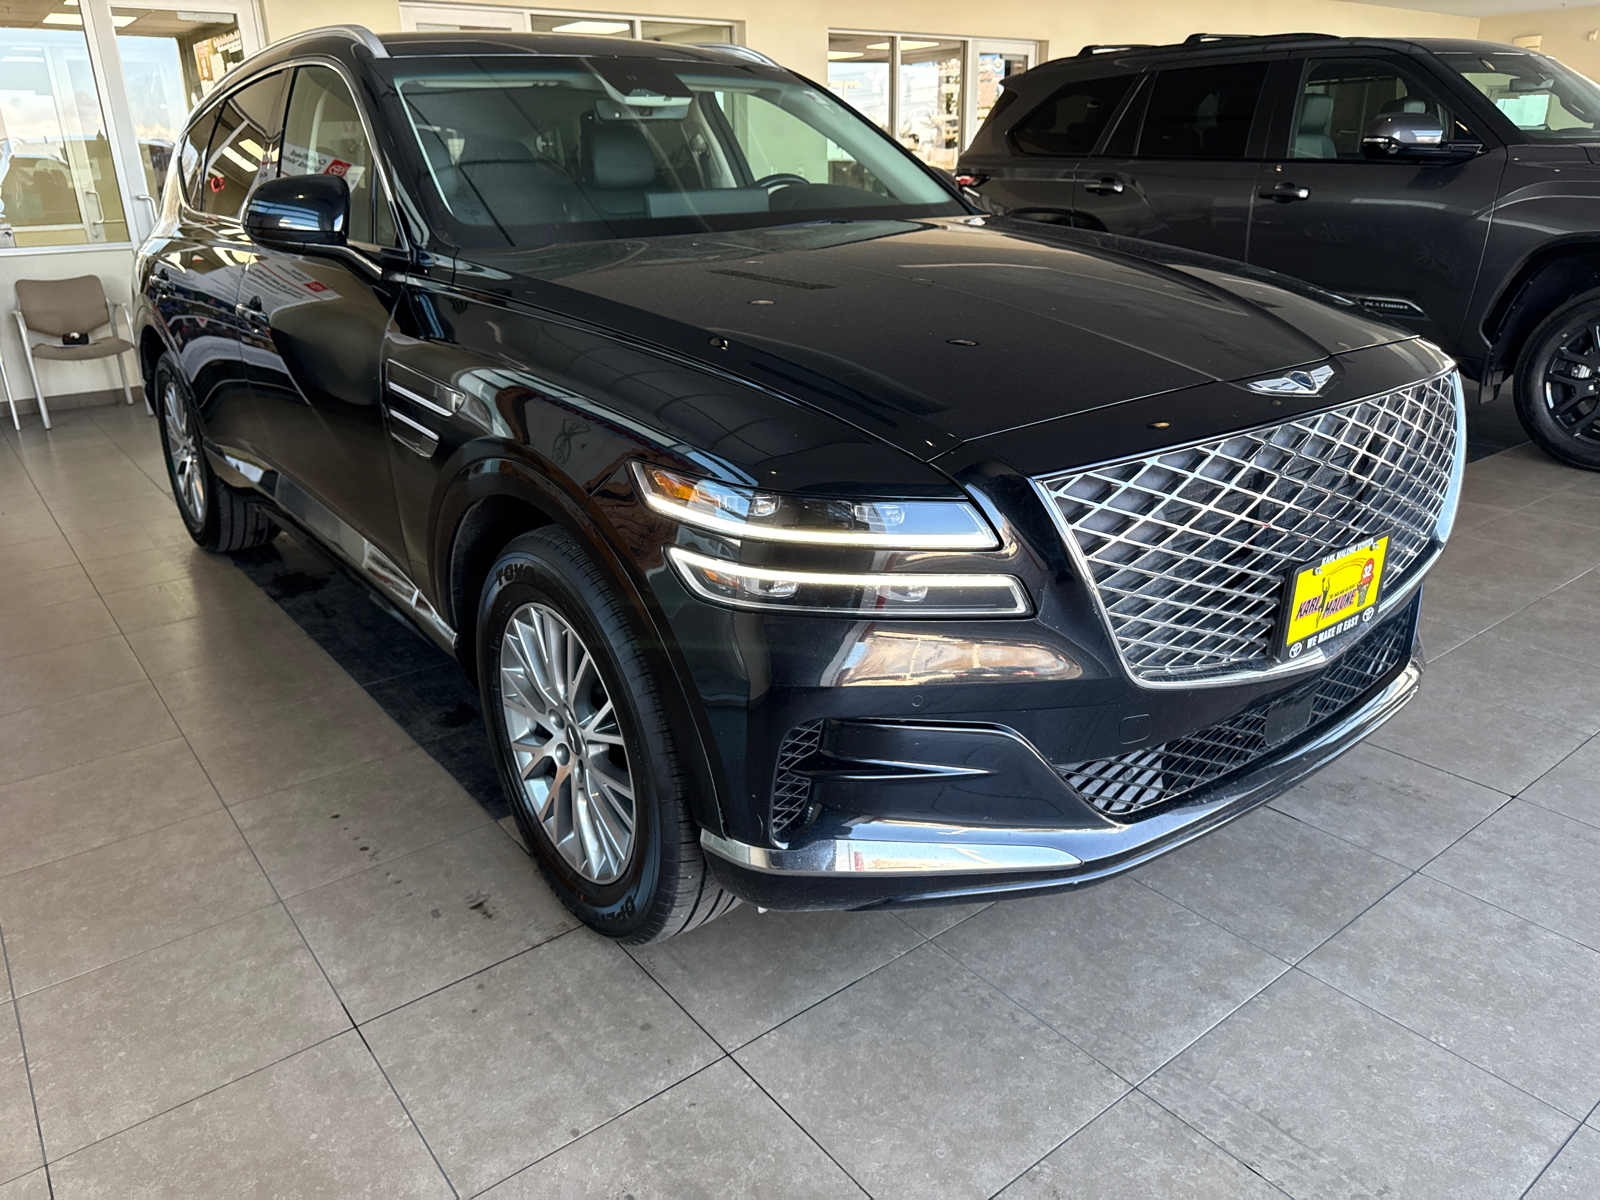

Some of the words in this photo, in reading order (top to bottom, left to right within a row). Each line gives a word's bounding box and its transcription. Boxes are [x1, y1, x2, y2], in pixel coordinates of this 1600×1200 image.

[1362, 563, 1373, 579] 32
[1295, 594, 1323, 621] KARL
[1322, 588, 1357, 620] MALONE
[1306, 635, 1318, 649] WE
[1317, 626, 1336, 644] MAKE
[1336, 622, 1344, 635] IT
[1343, 614, 1360, 631] EASY
